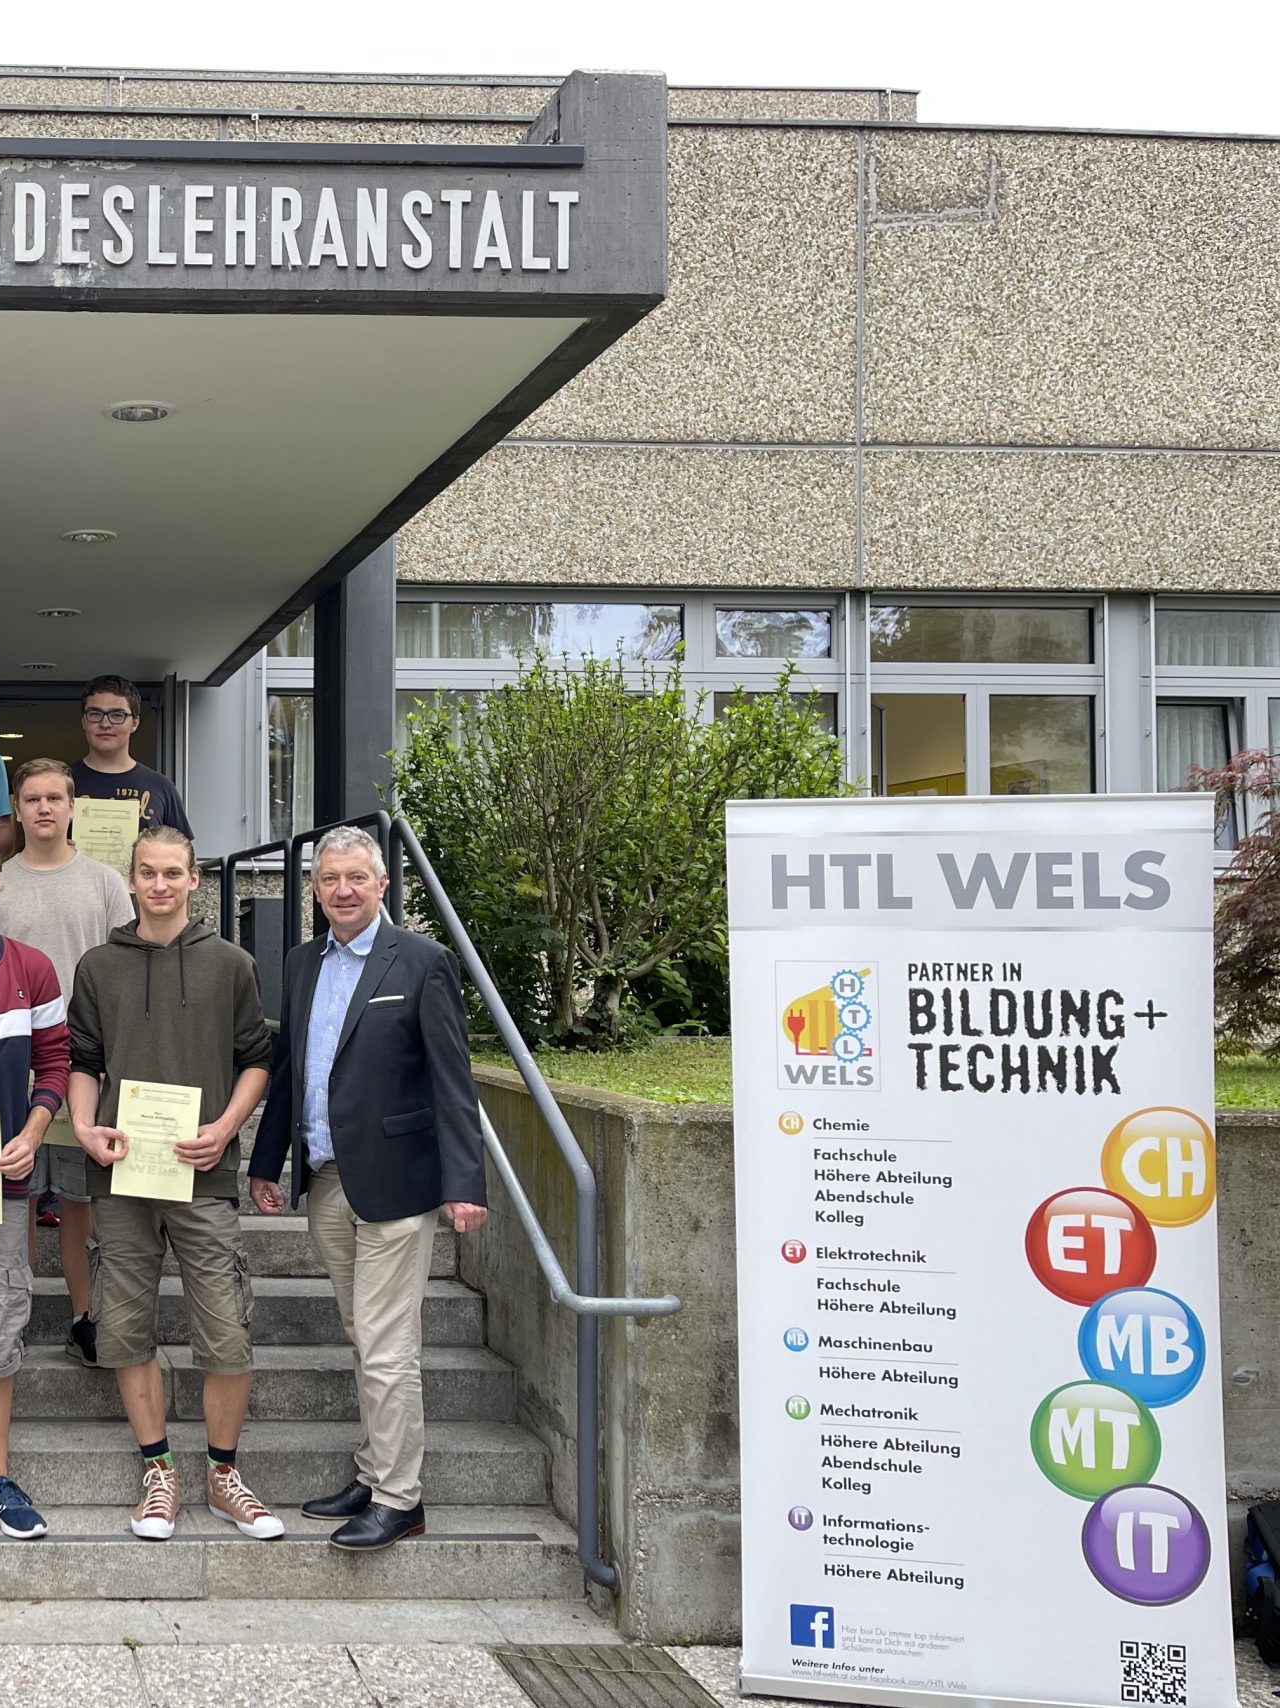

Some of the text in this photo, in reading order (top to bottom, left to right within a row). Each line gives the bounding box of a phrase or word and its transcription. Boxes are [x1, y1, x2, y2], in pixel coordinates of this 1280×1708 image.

[116, 788, 139, 797] 1973
[771, 850, 1171, 911] HTL WELS
[908, 962, 1022, 982] PARTNER IN
[784, 1064, 874, 1086] WELS
[908, 1042, 1122, 1095] TECHNIK
[782, 1117, 800, 1129] CH
[813, 1118, 870, 1131] Chemie
[814, 1148, 897, 1162] Fachschule
[1122, 1136, 1206, 1197] CH
[814, 1169, 953, 1188] Höhere Abteilung
[815, 1189, 915, 1204] Abendschule
[815, 1210, 864, 1227] Kolleg
[786, 1245, 803, 1258] ET
[1047, 1214, 1133, 1275] ET
[816, 1247, 927, 1263] Elektrotechnik
[817, 1277, 901, 1293] Fachschule
[817, 1298, 957, 1320] Höhere Abteilung
[786, 1333, 807, 1345] MB
[818, 1336, 933, 1353] Maschinenbau
[1096, 1314, 1194, 1376] MB
[819, 1366, 959, 1389] Höhere Abteilung
[788, 1402, 807, 1414] MT
[820, 1403, 919, 1421] Mechatronik
[821, 1434, 961, 1458] Höhere Abteilung
[1048, 1408, 1141, 1470] MT
[821, 1456, 923, 1474] Abendschule
[822, 1477, 871, 1495] Kolleg
[793, 1511, 808, 1525] IT
[823, 1514, 930, 1534] Informations-
[823, 1533, 915, 1553] technologie
[1117, 1511, 1180, 1574] IT
[824, 1563, 965, 1590] Höhere Abteilung
[841, 1625, 965, 1643] Hier bist Du immer top informiert
[841, 1644, 874, 1653] Schülern
[858, 1636, 882, 1645] kannst
[884, 1638, 902, 1646] Dich
[918, 1641, 950, 1651] anderen
[792, 1658, 885, 1674] Weitere Infos unter
[850, 1673, 868, 1682] oder
